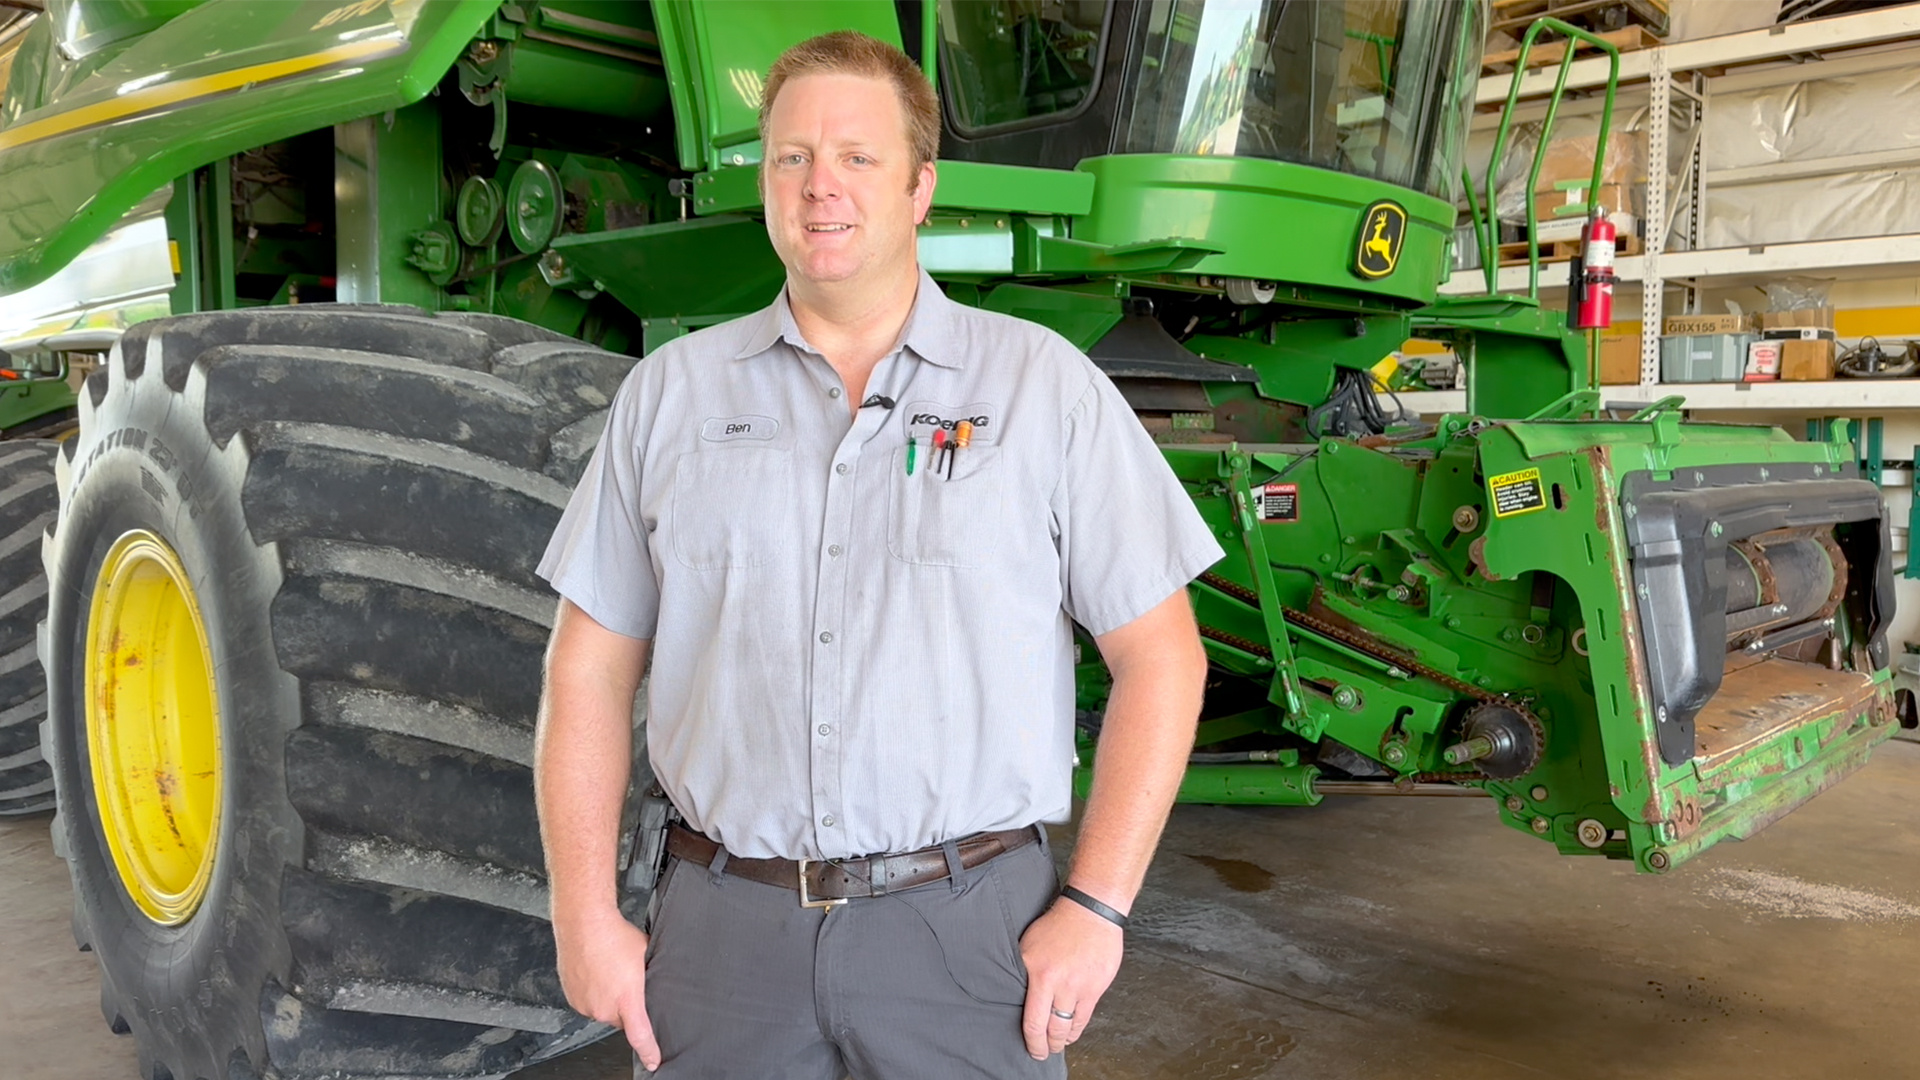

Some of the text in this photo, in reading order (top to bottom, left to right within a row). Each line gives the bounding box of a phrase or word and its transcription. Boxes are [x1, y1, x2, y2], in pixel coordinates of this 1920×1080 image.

[1668, 322, 1716, 333] GBX155
[725, 423, 752, 435] Ben
[1498, 470, 1537, 483] CAUTION
[1271, 484, 1296, 493] DANGER
